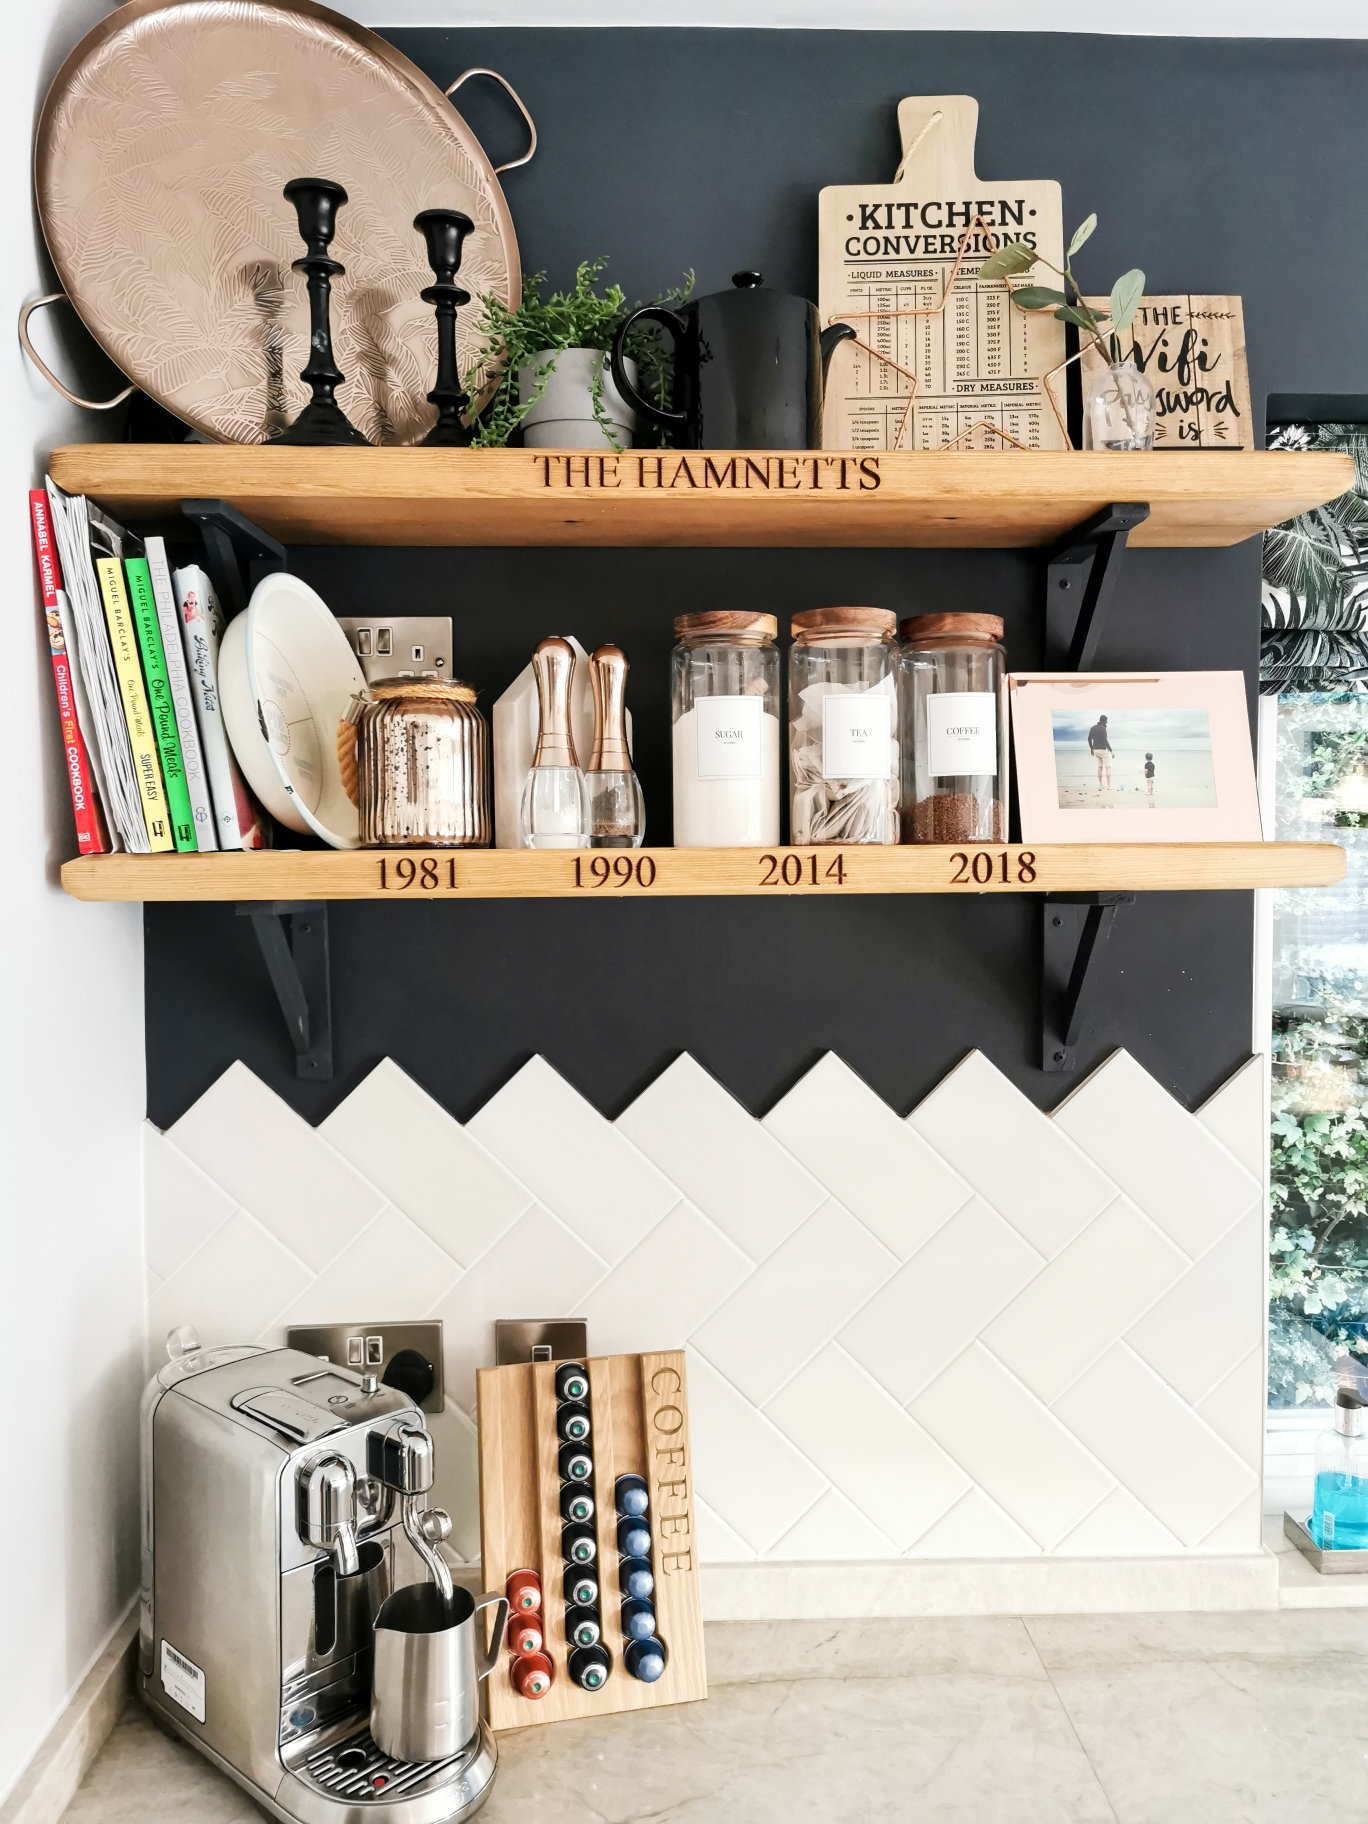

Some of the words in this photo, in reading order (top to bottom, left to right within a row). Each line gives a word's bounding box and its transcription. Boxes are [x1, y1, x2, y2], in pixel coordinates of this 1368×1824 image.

[859, 200, 1025, 230] KITCHEN
[846, 232, 1036, 256] CONVERSIONS
[1138, 306, 1183, 326] THE
[1110, 328, 1222, 386] Wifi
[980, 382, 1034, 391] MEASURES
[1178, 419, 1203, 441] is
[534, 455, 622, 488] THE
[638, 456, 881, 490] HAMNETTS
[34, 502, 48, 551] ANNABEL
[41, 555, 56, 598] KARMEL
[152, 561, 167, 585] THE
[107, 567, 119, 604] MIGUEL
[115, 609, 130, 661] BARCLAY'S
[136, 576, 148, 612] MIGUEL
[144, 617, 159, 669] BARCLAY'S
[158, 591, 181, 693] PHILADELPHIA
[56, 665, 70, 717] Children's
[152, 679, 165, 700] One
[64, 720, 75, 744] First
[156, 701, 170, 742] Pound
[946, 727, 980, 735] COFFEE
[176, 697, 200, 781] COOKBOOK
[140, 754, 152, 779] SUPER
[163, 741, 182, 779] Meals
[69, 747, 85, 811] COOKBOOK
[145, 779, 158, 801] EASY
[376, 857, 459, 891] 1981
[570, 856, 656, 888] 1990
[758, 854, 847, 886] 2014
[950, 852, 1037, 884] 2018
[651, 1366, 692, 1576] COFFEE
